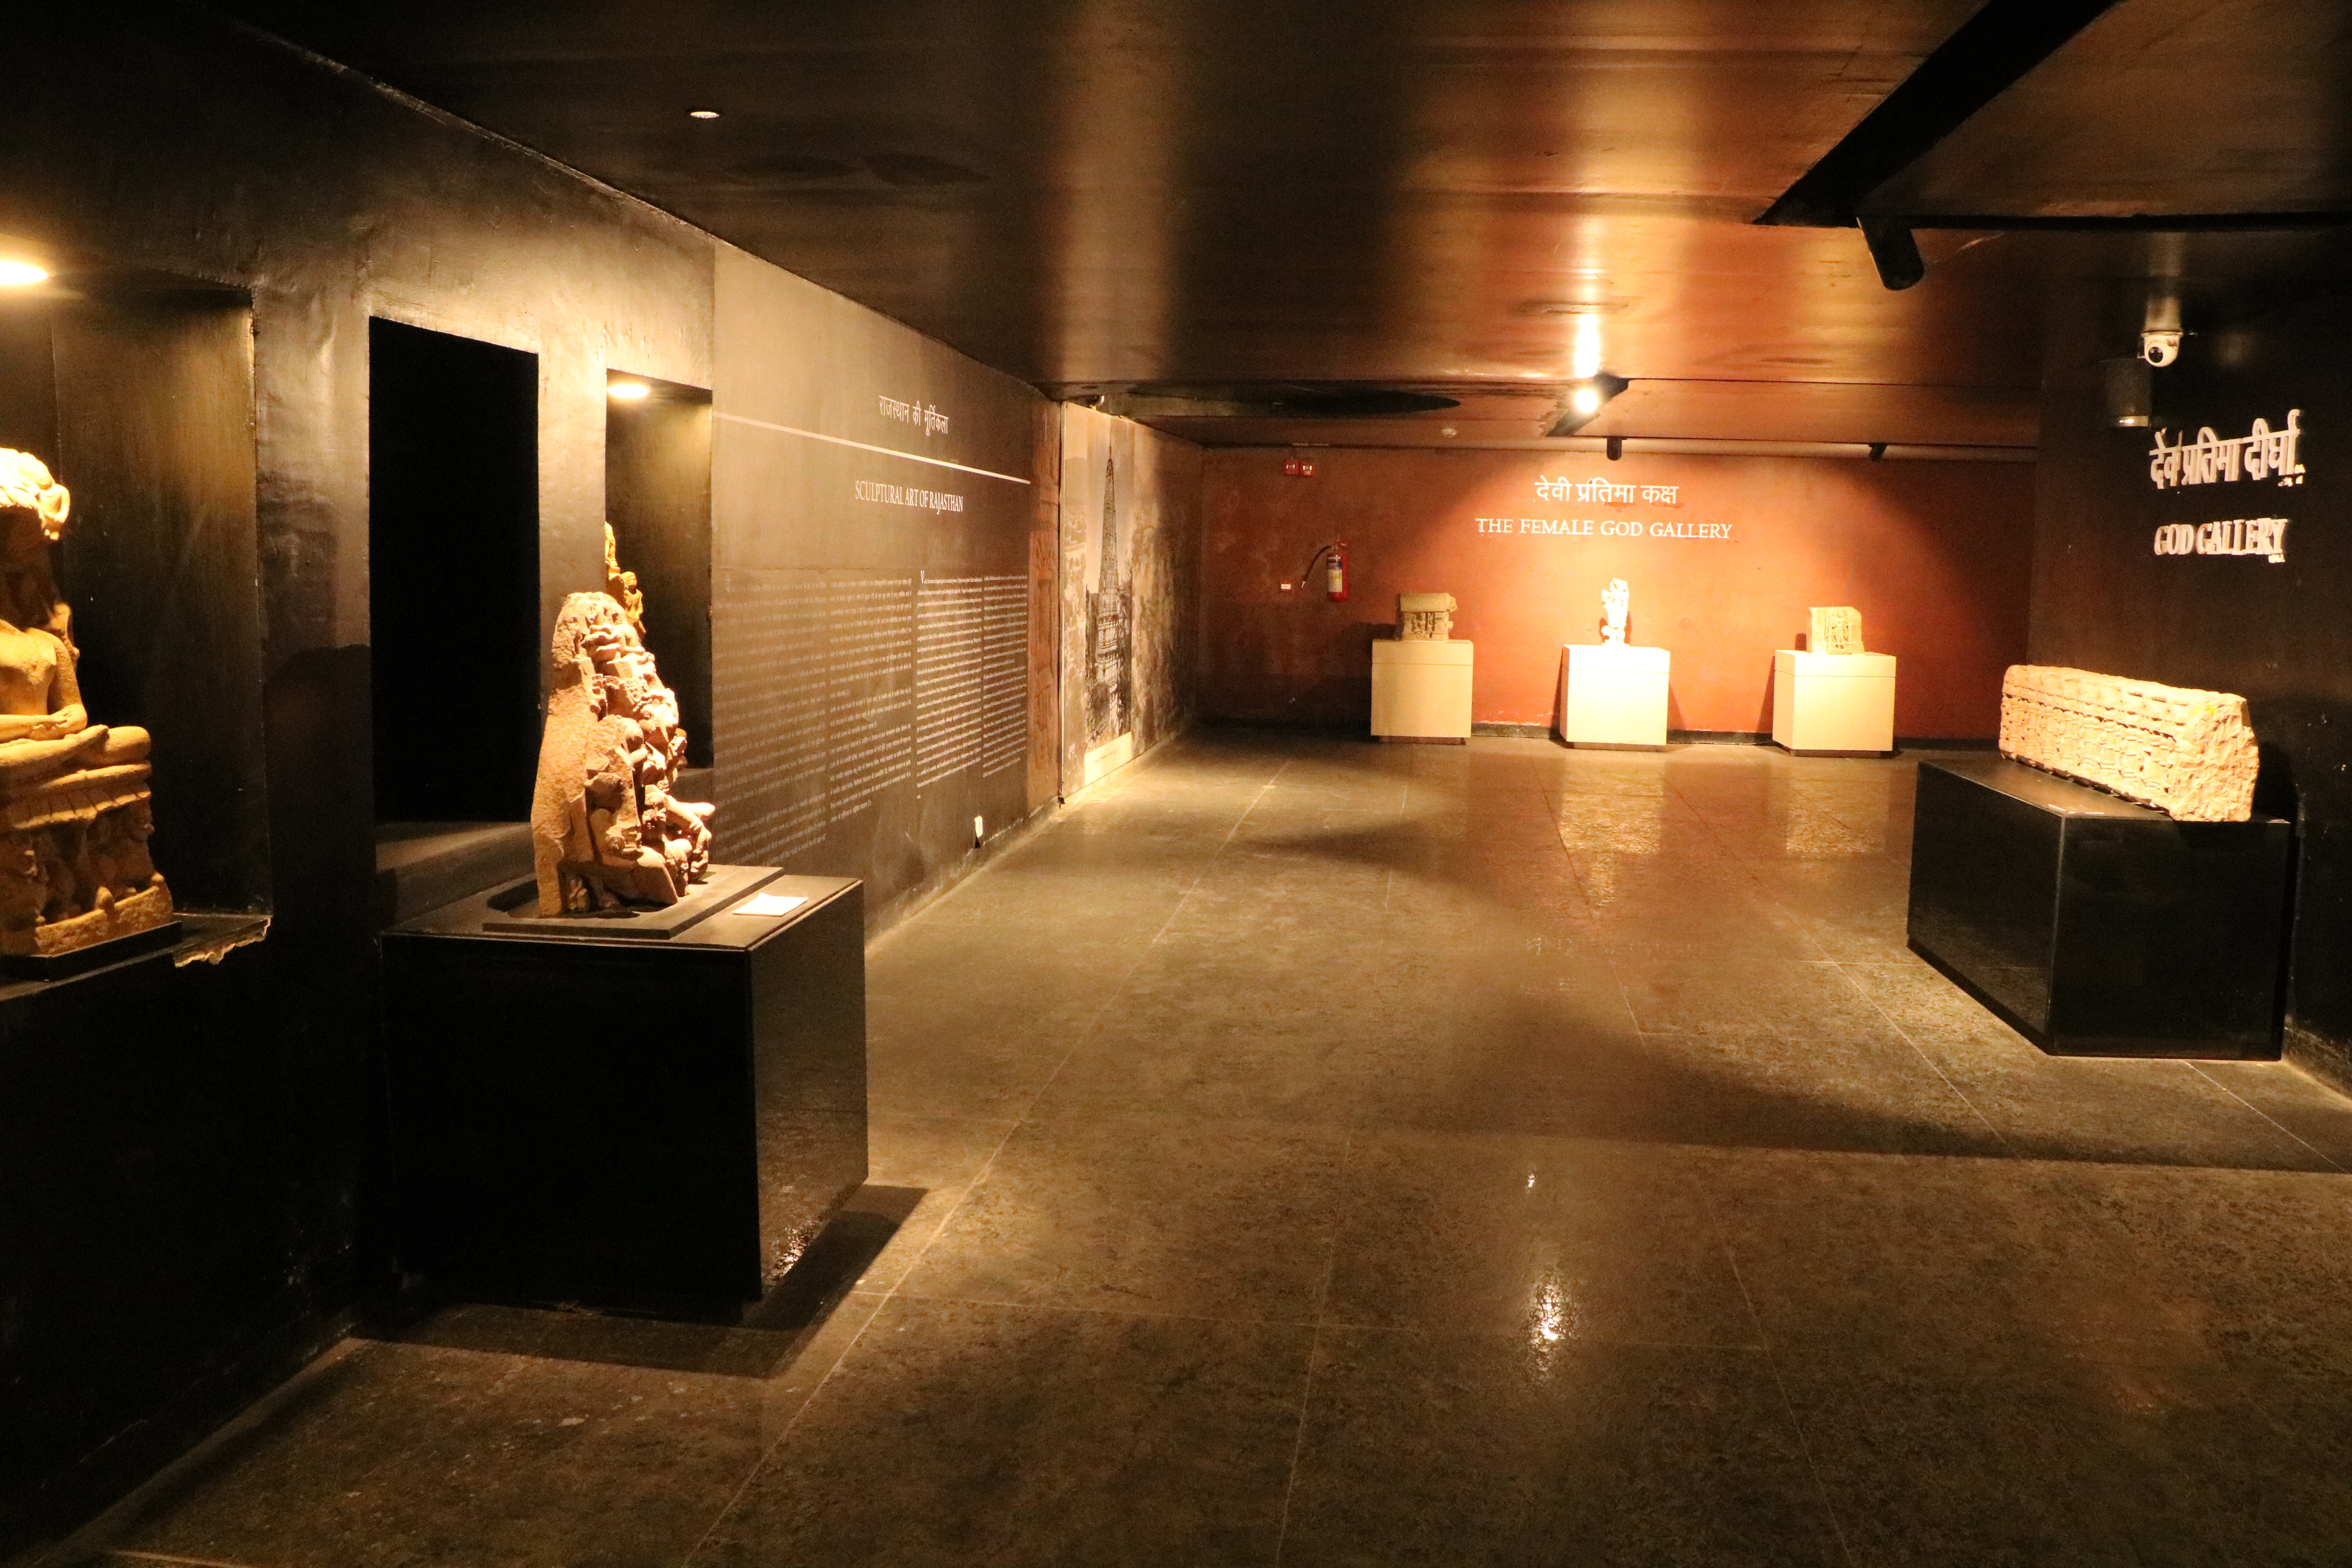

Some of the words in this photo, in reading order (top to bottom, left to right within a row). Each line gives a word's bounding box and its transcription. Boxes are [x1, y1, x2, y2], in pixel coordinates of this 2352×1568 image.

[879, 395, 909, 423] राजस्थान
[912, 400, 921, 426] की
[924, 405, 949, 436] मूर्तिकला
[855, 480, 904, 505] SCULPTURAL
[905, 487, 919, 506] ART
[919, 490, 928, 508] OF
[929, 491, 963, 515] RAJASTHAN
[1534, 475, 1572, 501] देवी
[1576, 477, 1637, 503] प्रतिमा
[1640, 485, 1679, 504] कक्ष
[1476, 518, 1513, 533] THE
[1519, 519, 1594, 535] FEMALE
[1600, 520, 1643, 536] GOD
[1650, 521, 1733, 539] GALLERY
[2154, 524, 2194, 555] GOD
[2196, 518, 2288, 556] GALLERY
